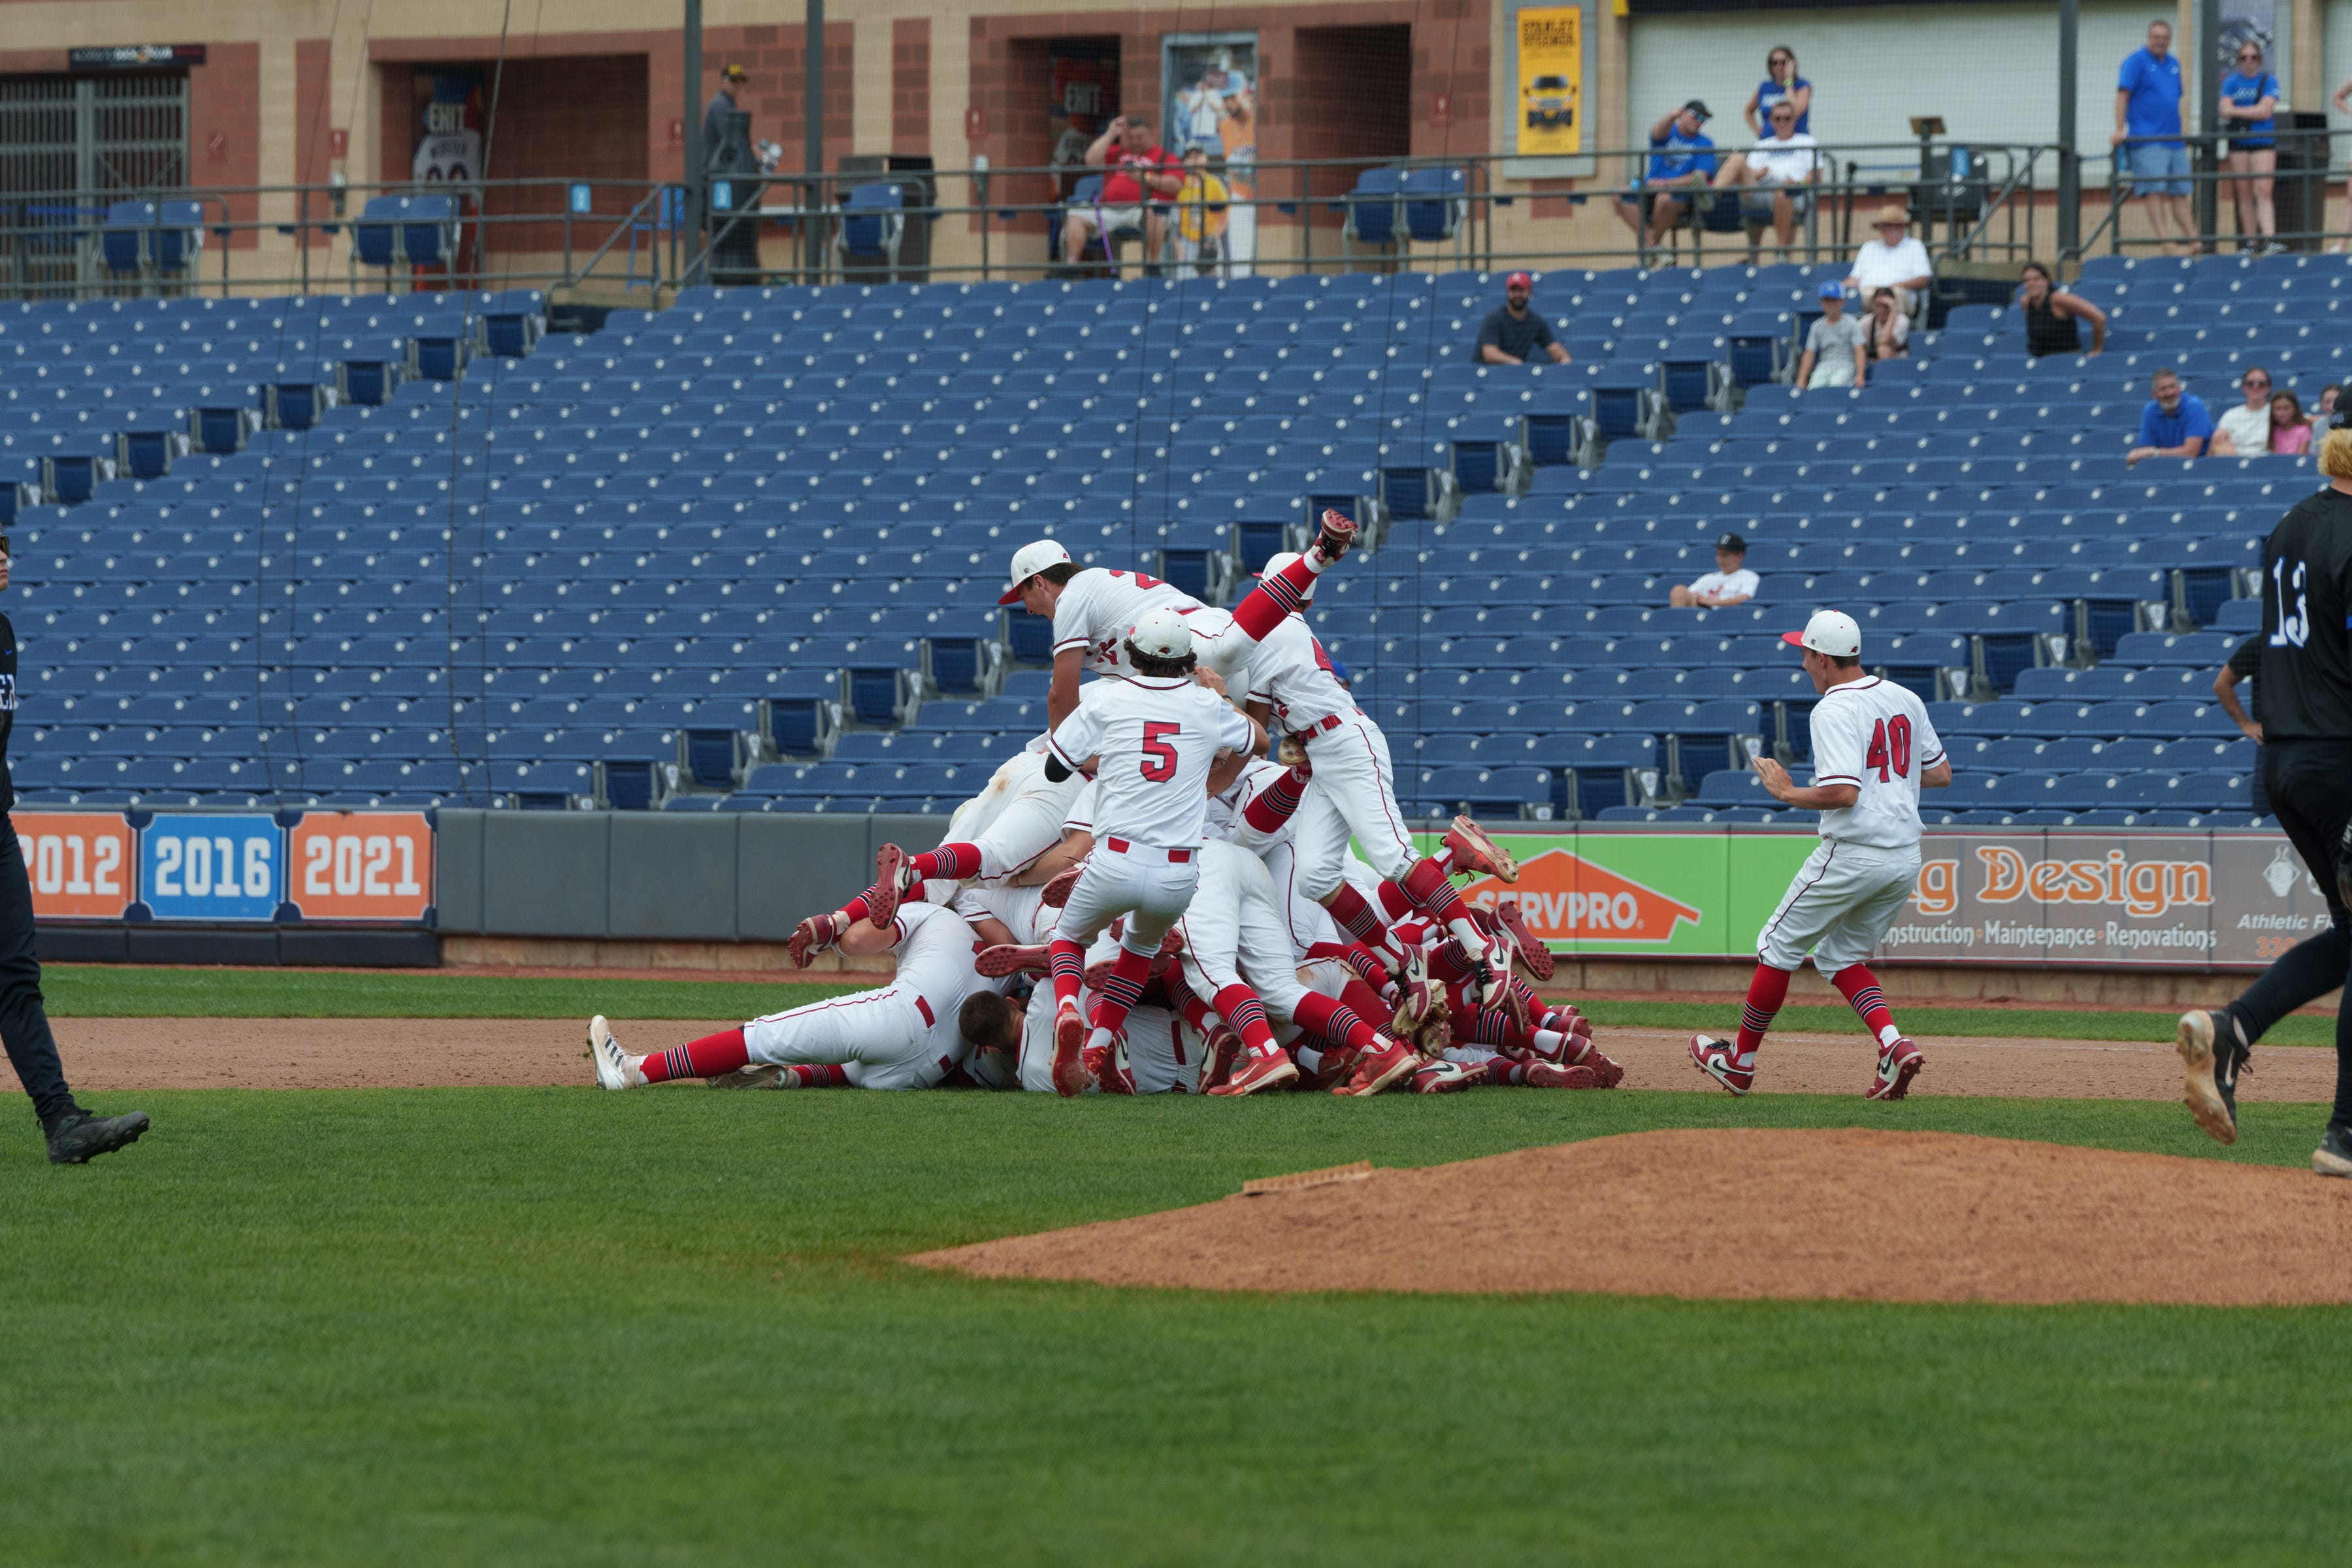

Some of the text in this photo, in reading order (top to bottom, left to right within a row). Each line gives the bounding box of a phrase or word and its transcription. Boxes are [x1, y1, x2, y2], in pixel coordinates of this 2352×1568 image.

[429, 103, 468, 133] EXIT
[1064, 83, 1102, 114] EXIT
[1139, 721, 1181, 783] 5
[1867, 713, 1912, 783] 40
[155, 836, 271, 898] 2016
[304, 834, 421, 896] 2021
[1975, 845, 2215, 918] Design
[1880, 919, 2217, 951] nstruction Maintenance Renovations
[2236, 913, 2310, 930] Athletic
